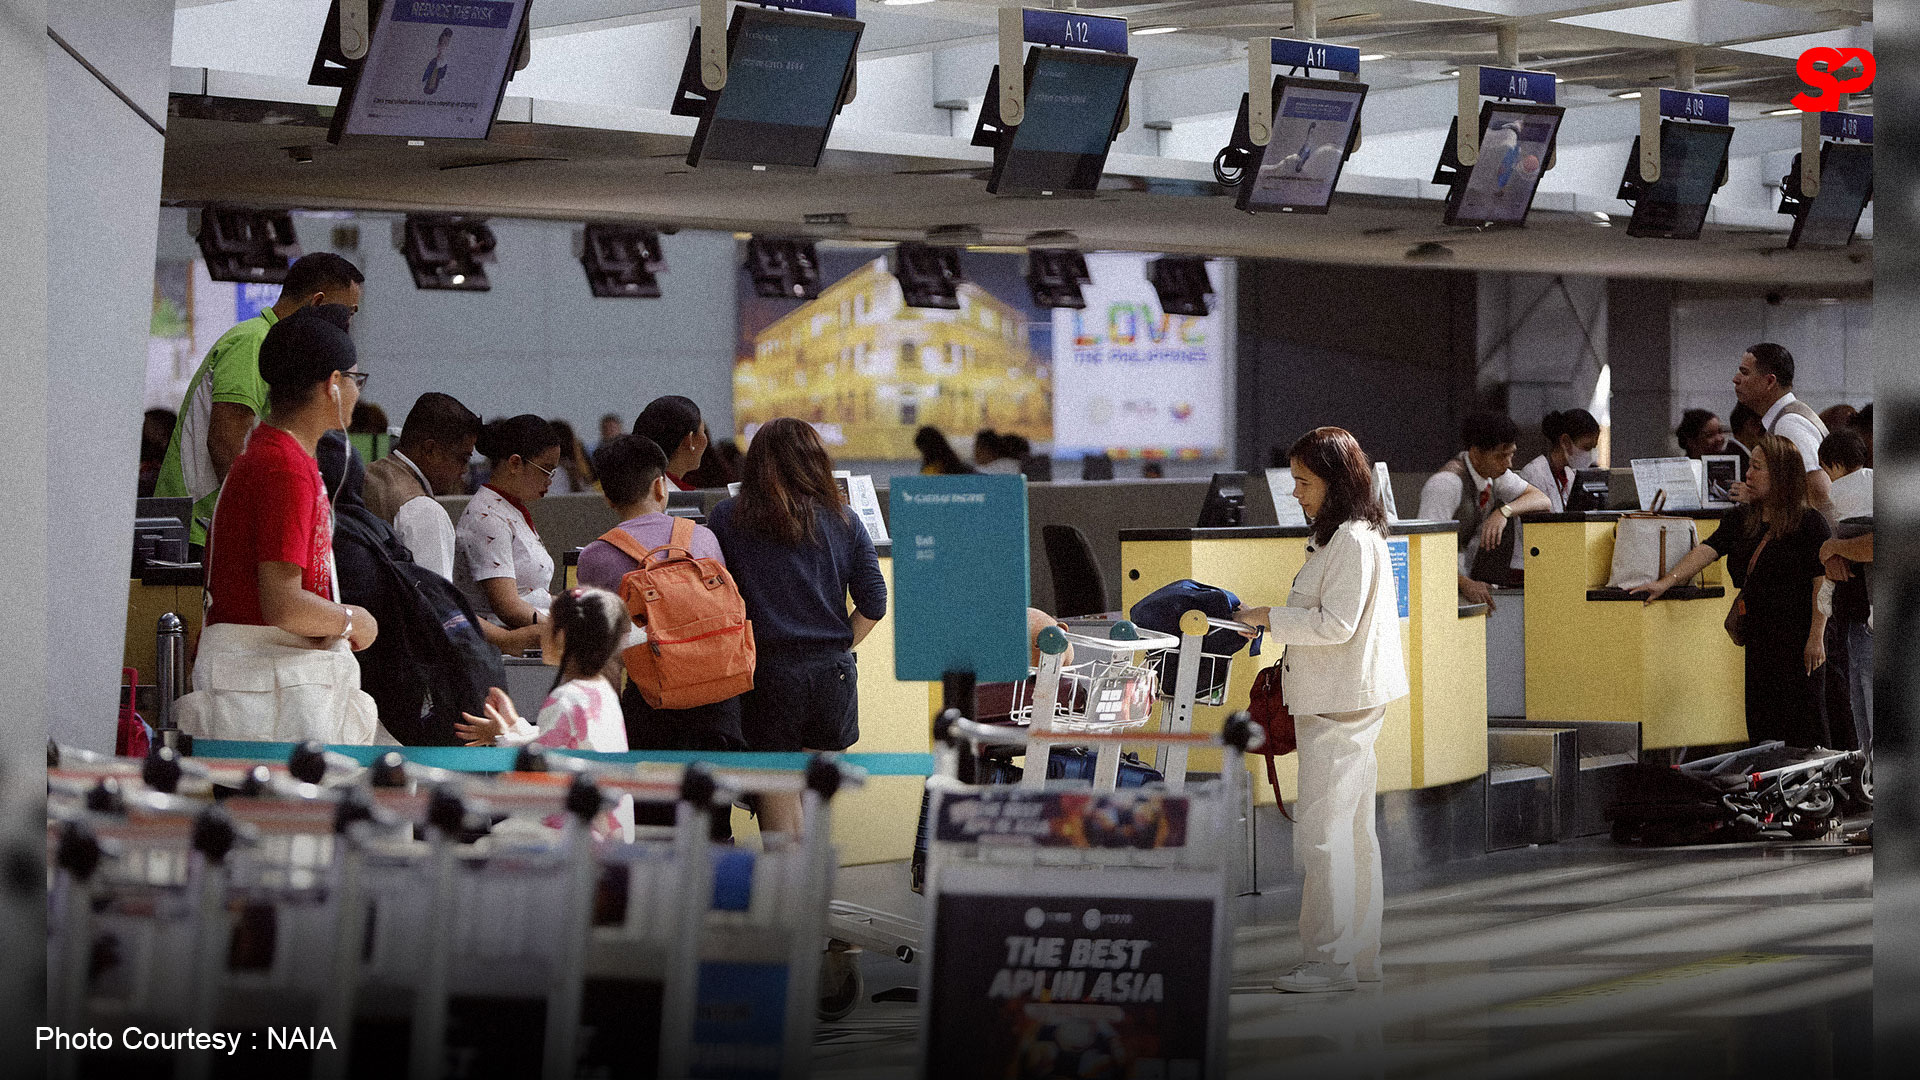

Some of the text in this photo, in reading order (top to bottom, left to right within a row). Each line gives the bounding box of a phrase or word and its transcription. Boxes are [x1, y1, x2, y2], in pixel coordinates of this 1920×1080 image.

[1005, 935, 1152, 970] THE BEST
[1090, 972, 1164, 1002] ASIA
